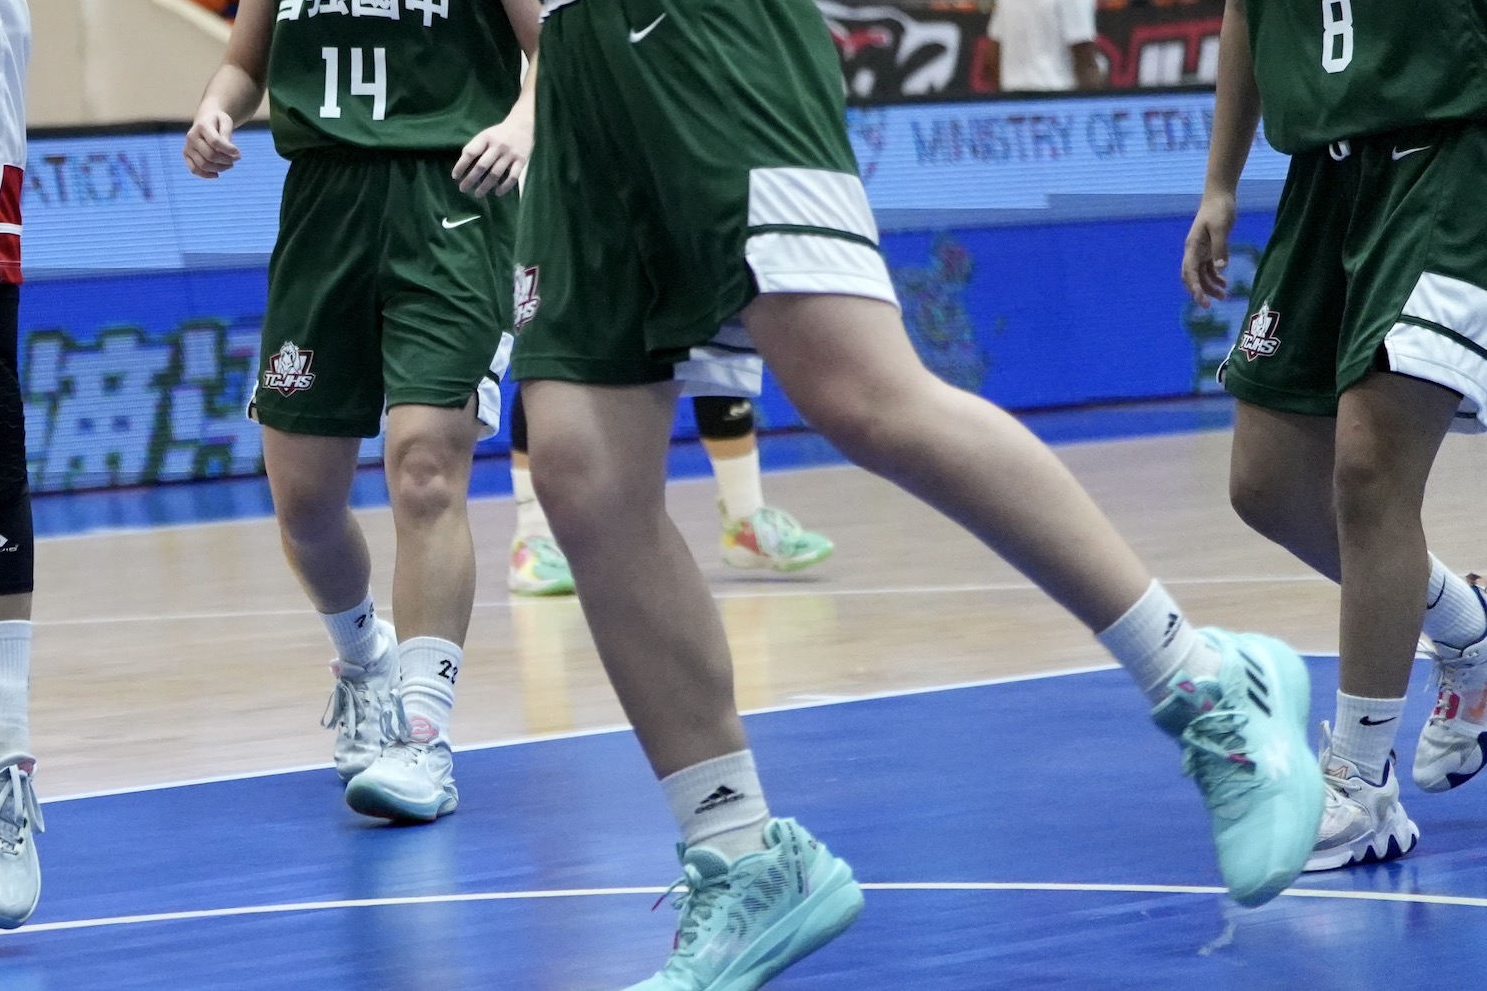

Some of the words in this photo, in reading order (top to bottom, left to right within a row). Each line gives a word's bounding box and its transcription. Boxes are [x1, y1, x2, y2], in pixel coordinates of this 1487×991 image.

[319, 46, 387, 121] 14
[1239, 333, 1279, 355] TCJHS
[264, 371, 314, 389] TCJHS
